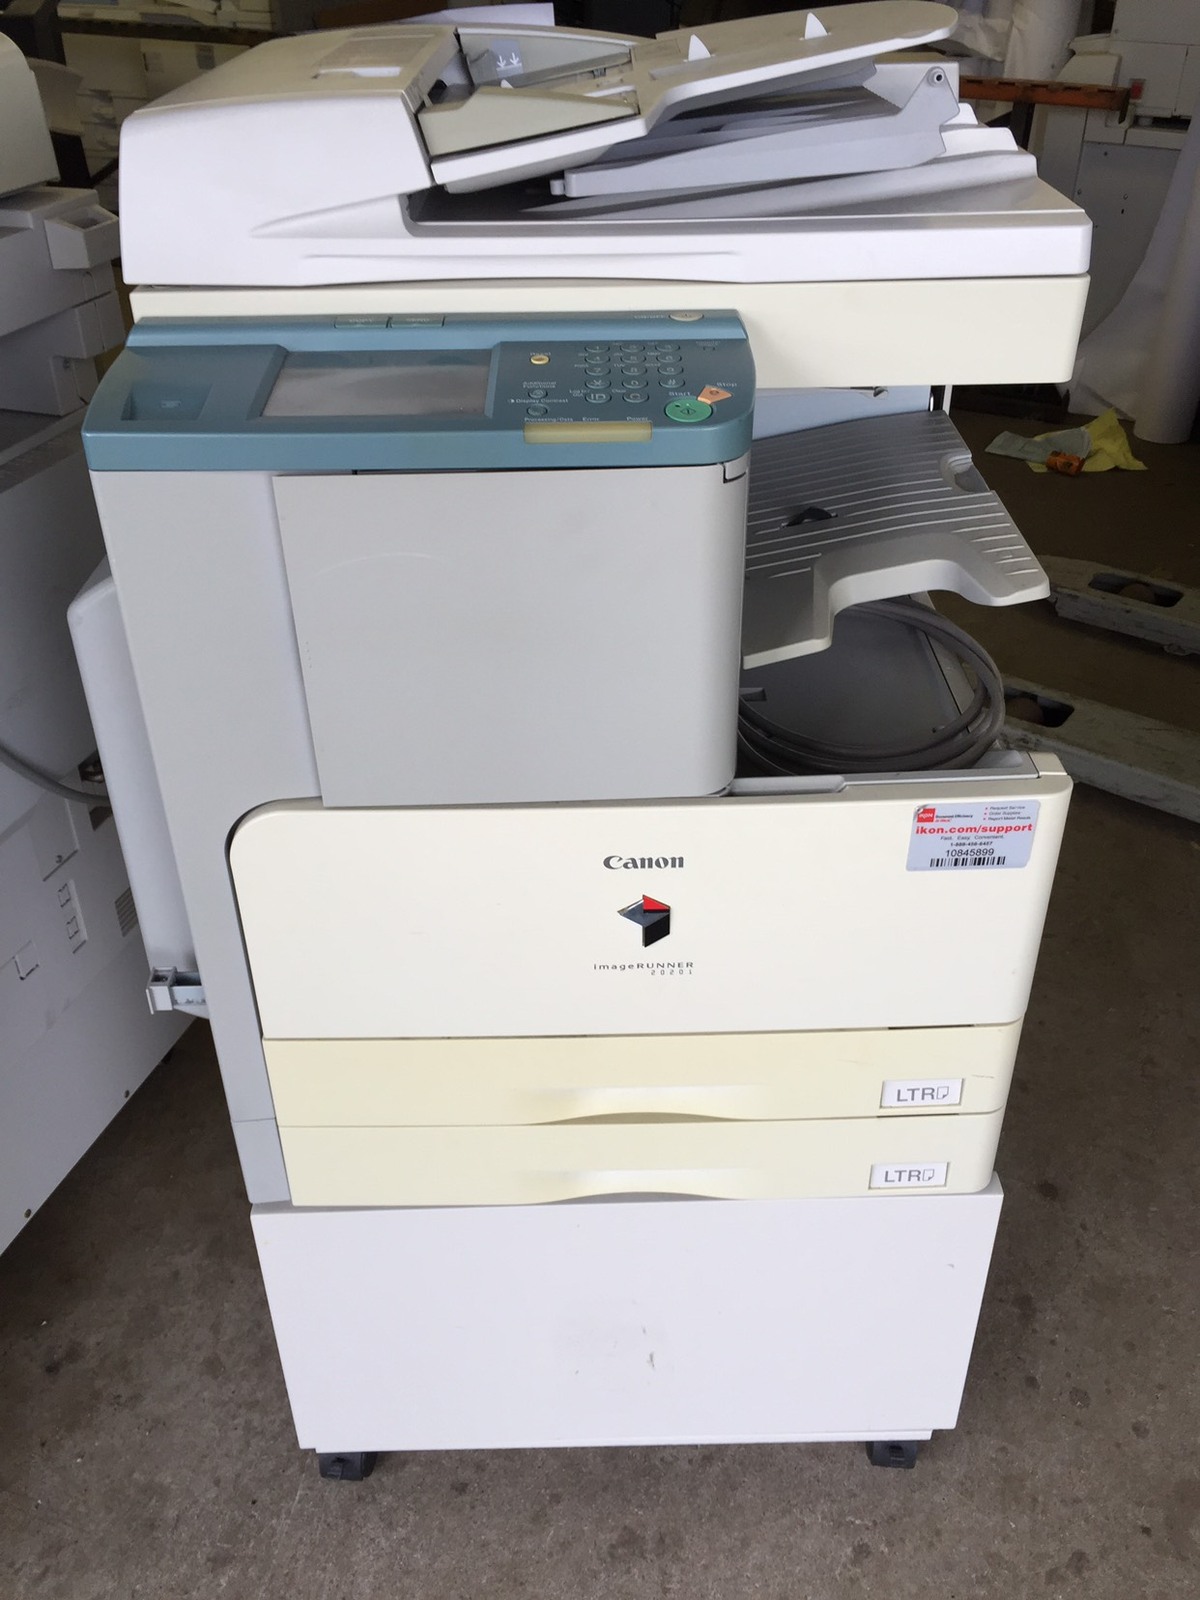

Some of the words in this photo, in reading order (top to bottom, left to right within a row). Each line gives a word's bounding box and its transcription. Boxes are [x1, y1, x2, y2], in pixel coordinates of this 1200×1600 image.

[915, 823, 1033, 835] ikon.com/support
[945, 848, 995, 858] 10845899
[603, 855, 684, 870] Canon
[593, 962, 694, 971] imageRUNNER
[896, 1087, 936, 1102] LTR
[884, 1169, 921, 1183] LTR
